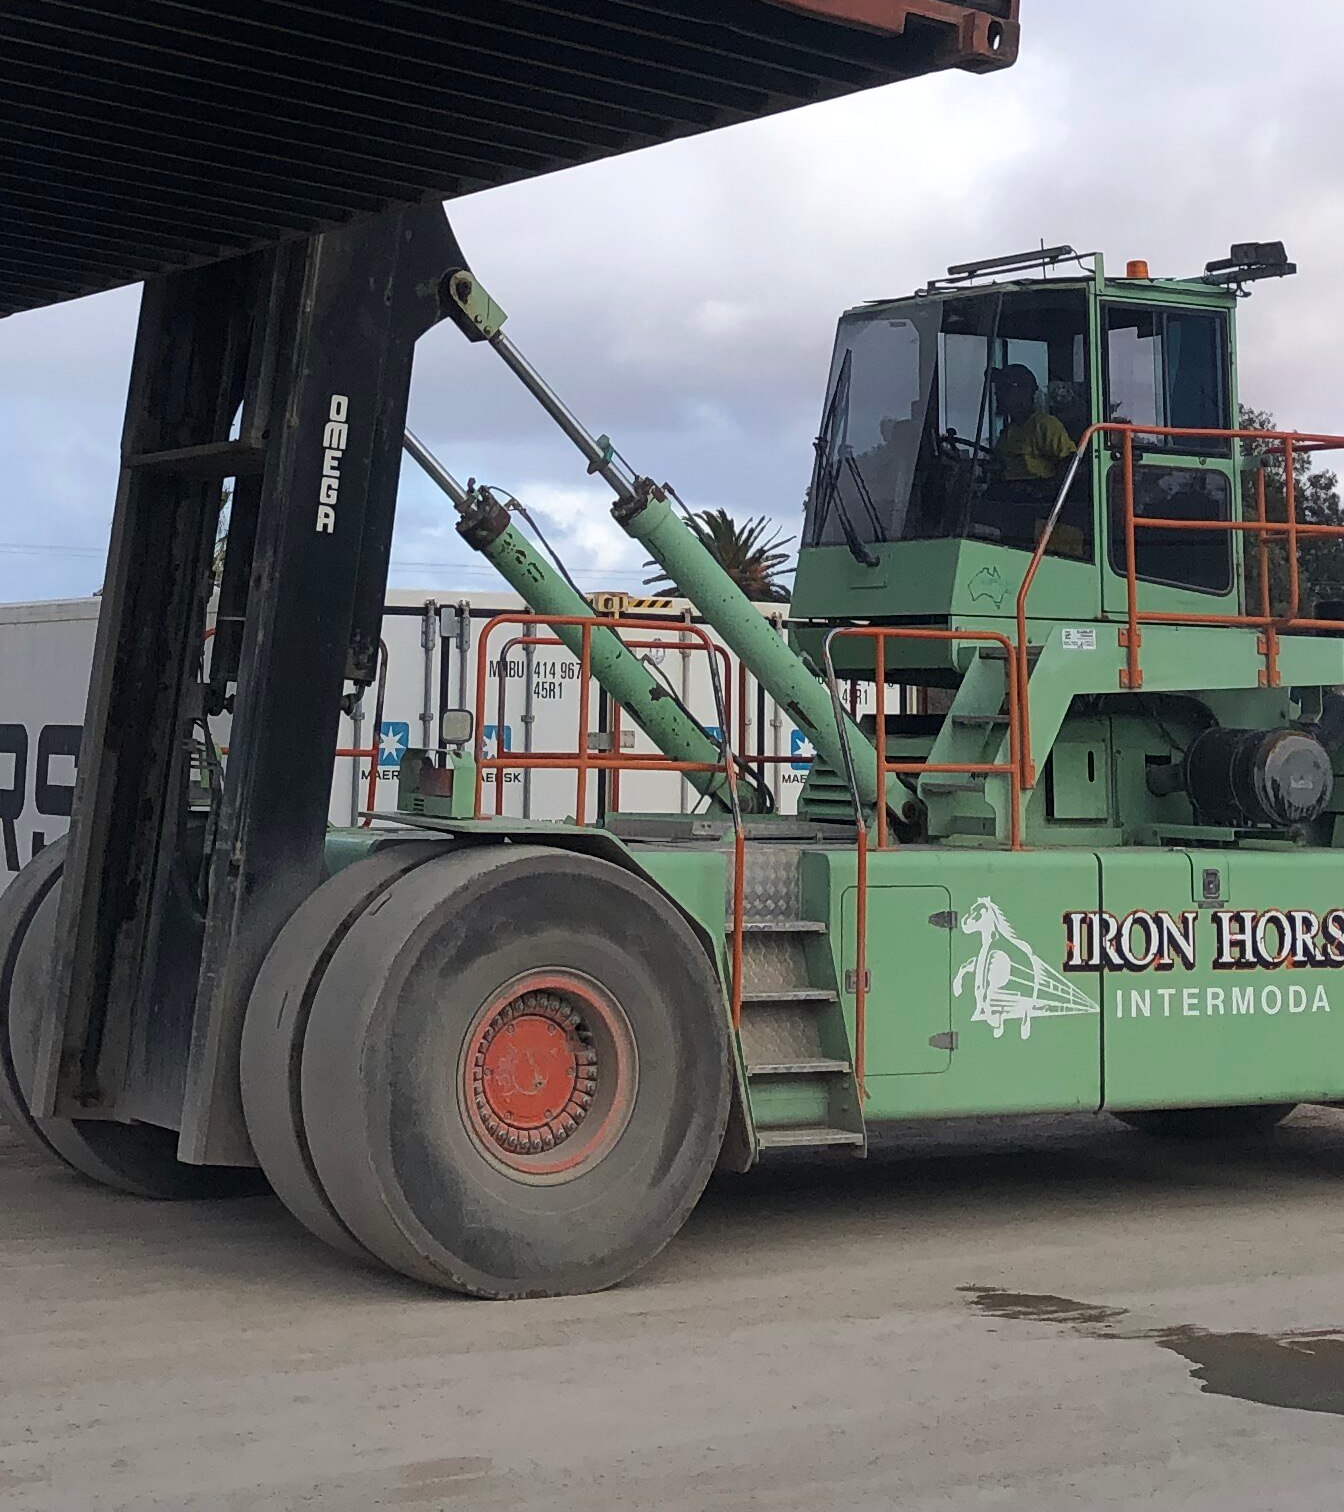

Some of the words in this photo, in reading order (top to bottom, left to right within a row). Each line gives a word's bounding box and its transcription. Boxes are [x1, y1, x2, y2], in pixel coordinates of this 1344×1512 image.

[316, 394, 349, 534] OMEGA
[489, 660, 525, 679] MBU
[534, 661, 556, 679] 414
[534, 681, 564, 699] 45R1
[841, 688, 869, 706] 4R1
[1062, 909, 1199, 972] IRON
[1116, 985, 1331, 1018] INTERMODA
